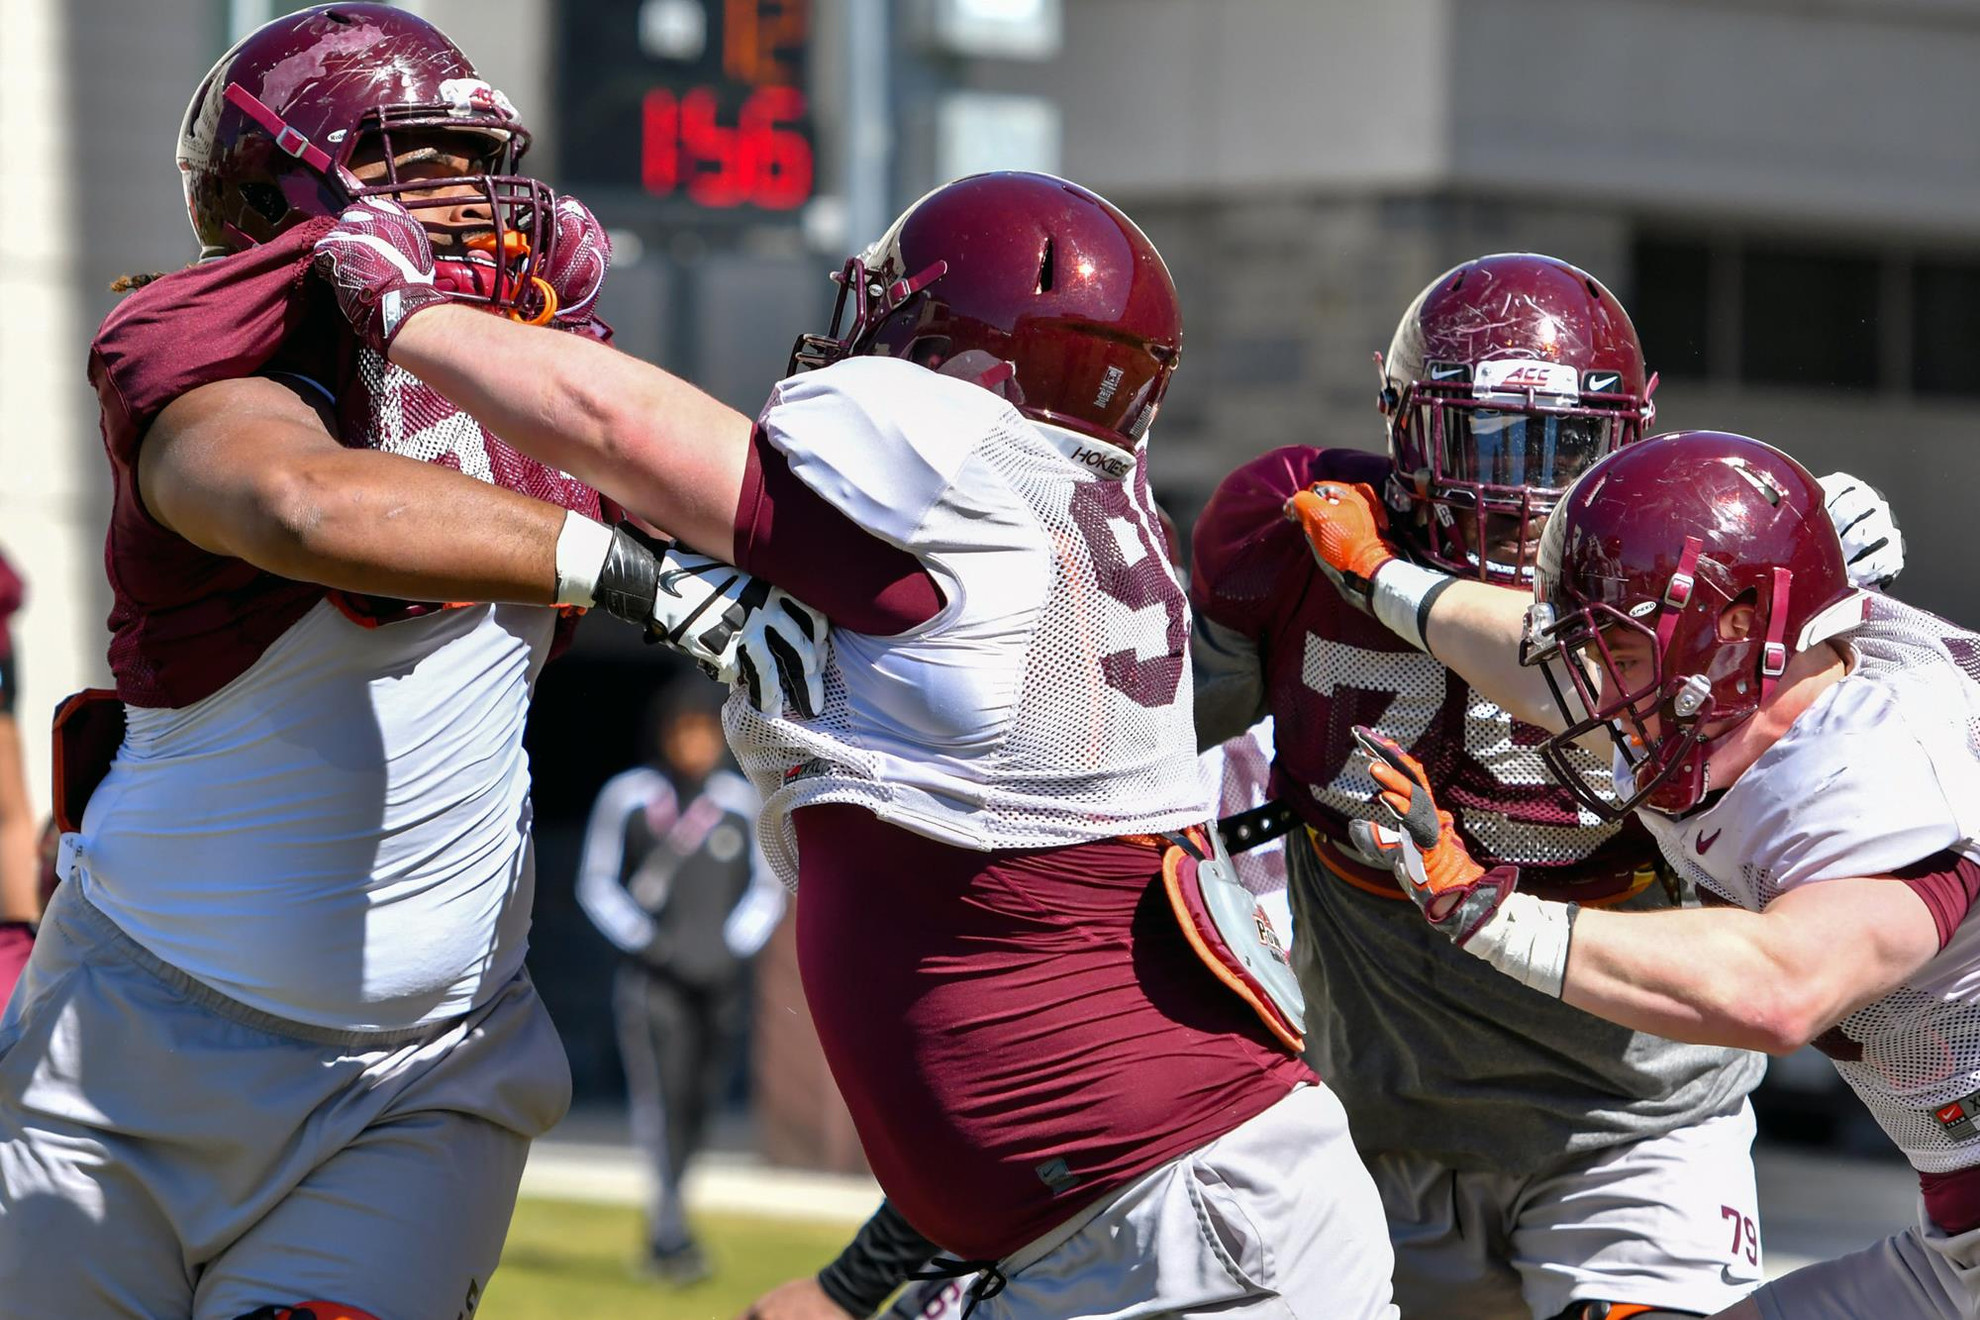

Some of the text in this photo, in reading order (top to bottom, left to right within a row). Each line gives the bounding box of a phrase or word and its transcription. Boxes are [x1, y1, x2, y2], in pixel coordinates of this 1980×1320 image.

[1506, 367, 1550, 381] ACC
[1070, 446, 1129, 478] HOKIES
[1721, 1204, 1757, 1267] 79
